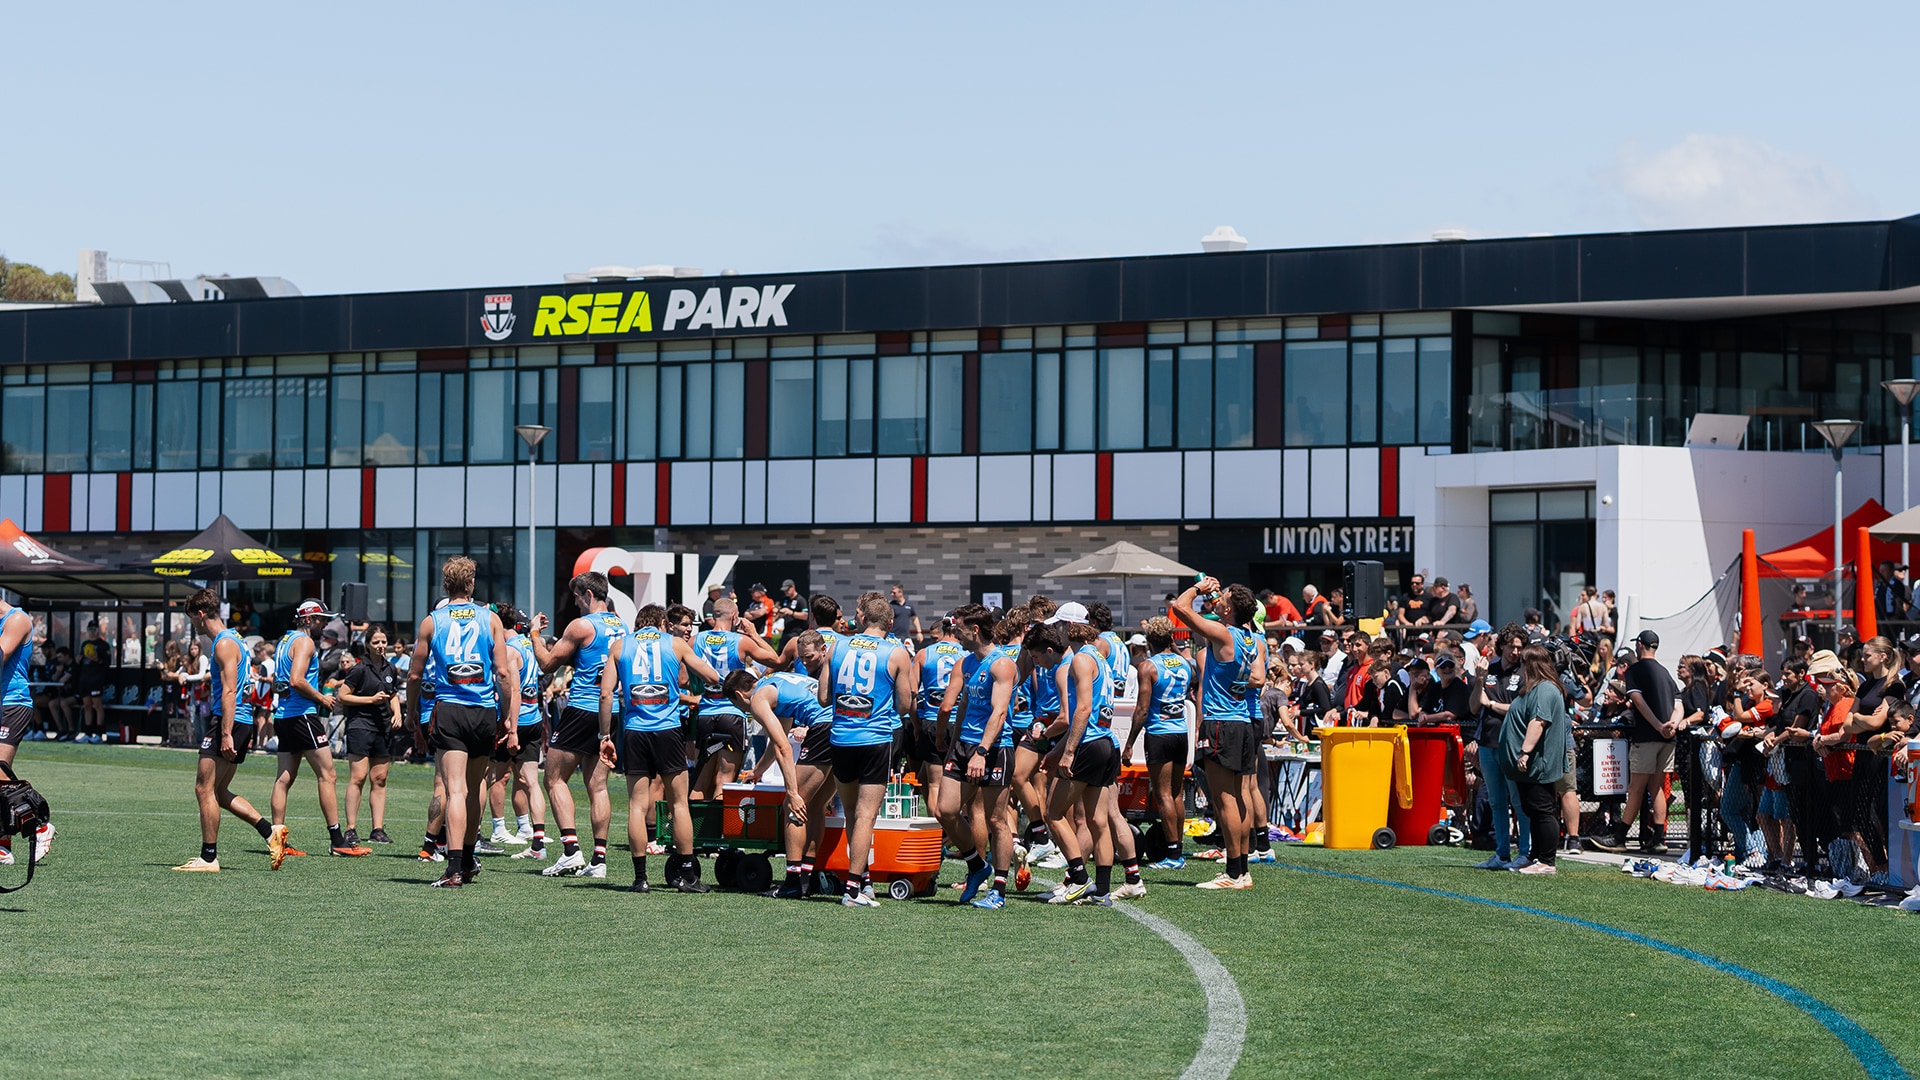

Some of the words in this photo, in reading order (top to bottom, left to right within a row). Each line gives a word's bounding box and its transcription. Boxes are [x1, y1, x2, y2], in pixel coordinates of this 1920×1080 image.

[533, 291, 653, 337] RSEA
[662, 284, 796, 331] PARK
[1263, 525, 1335, 555] LINTON
[1339, 525, 1414, 554] STREET
[573, 546, 739, 638] STK
[445, 620, 481, 662] 42
[632, 641, 662, 682] 41
[837, 649, 878, 695] 49
[937, 655, 956, 689] 6
[631, 697, 669, 705] CHERY
[1161, 668, 1188, 702] 23
[836, 708, 871, 719] CHERY
